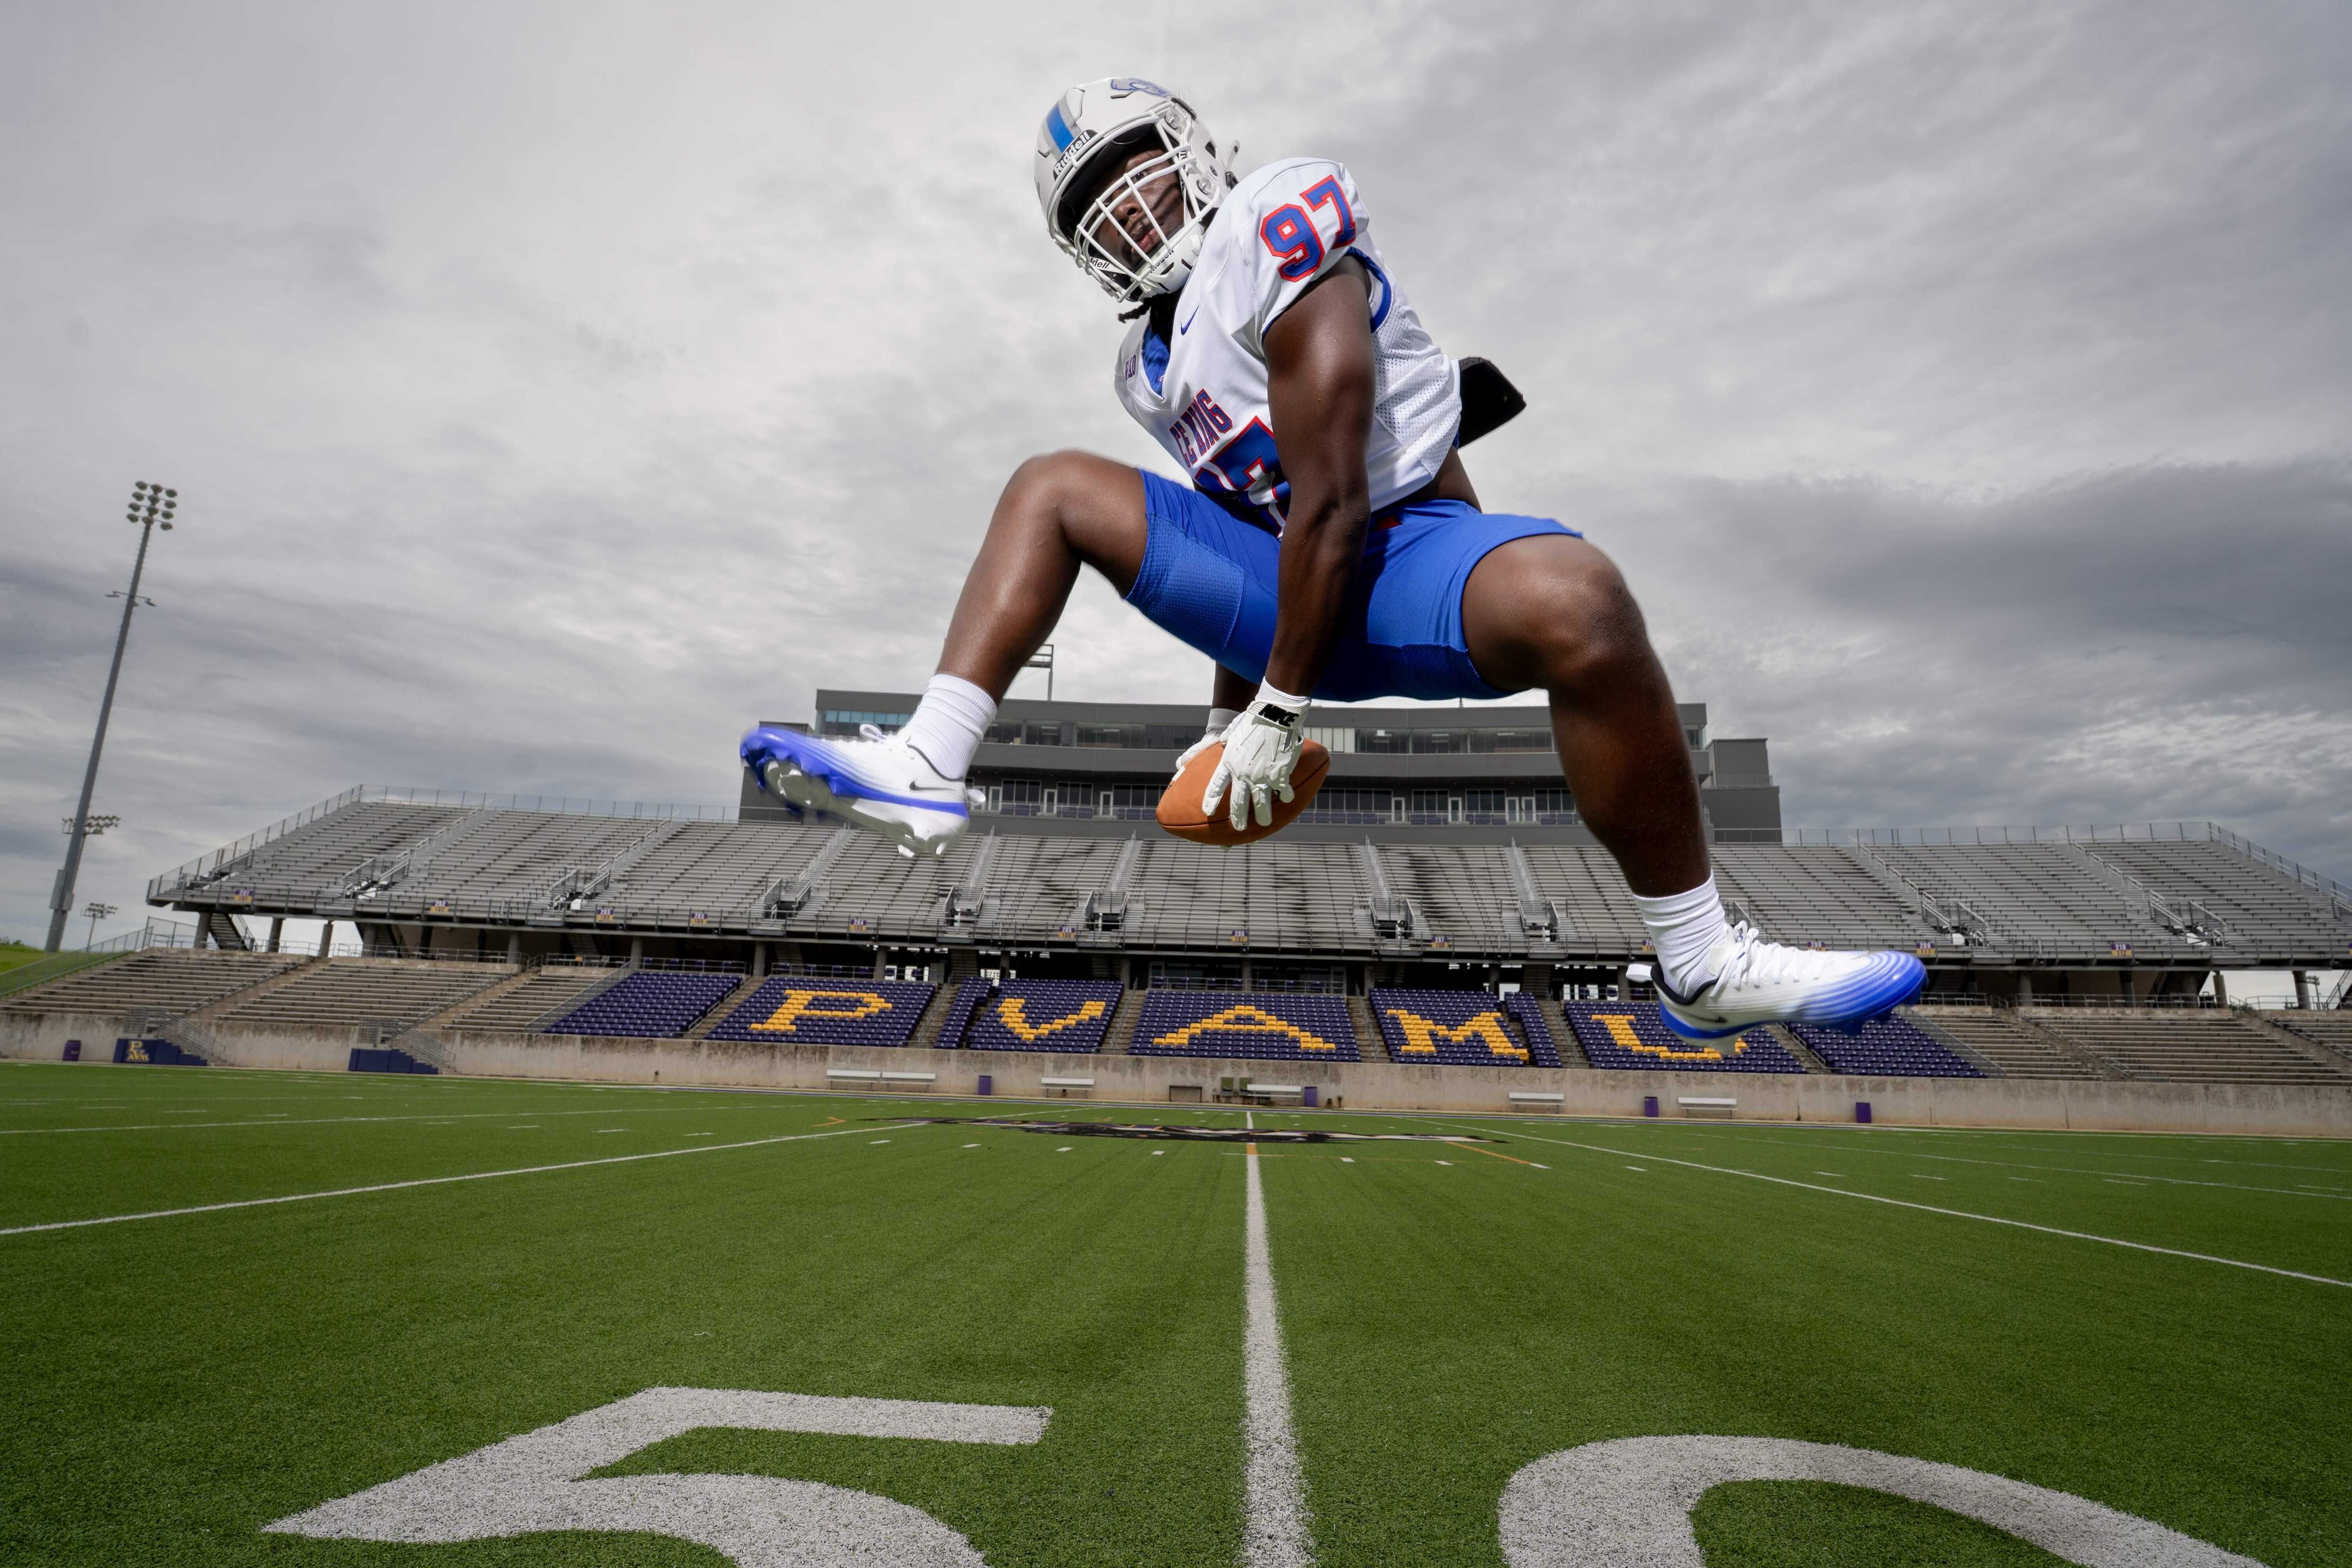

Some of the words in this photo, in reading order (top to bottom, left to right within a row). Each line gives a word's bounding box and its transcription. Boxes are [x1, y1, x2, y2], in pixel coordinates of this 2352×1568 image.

[1054, 131, 1090, 176] Riddell
[1260, 174, 1357, 283] 97
[1258, 703, 1299, 727] NIKE
